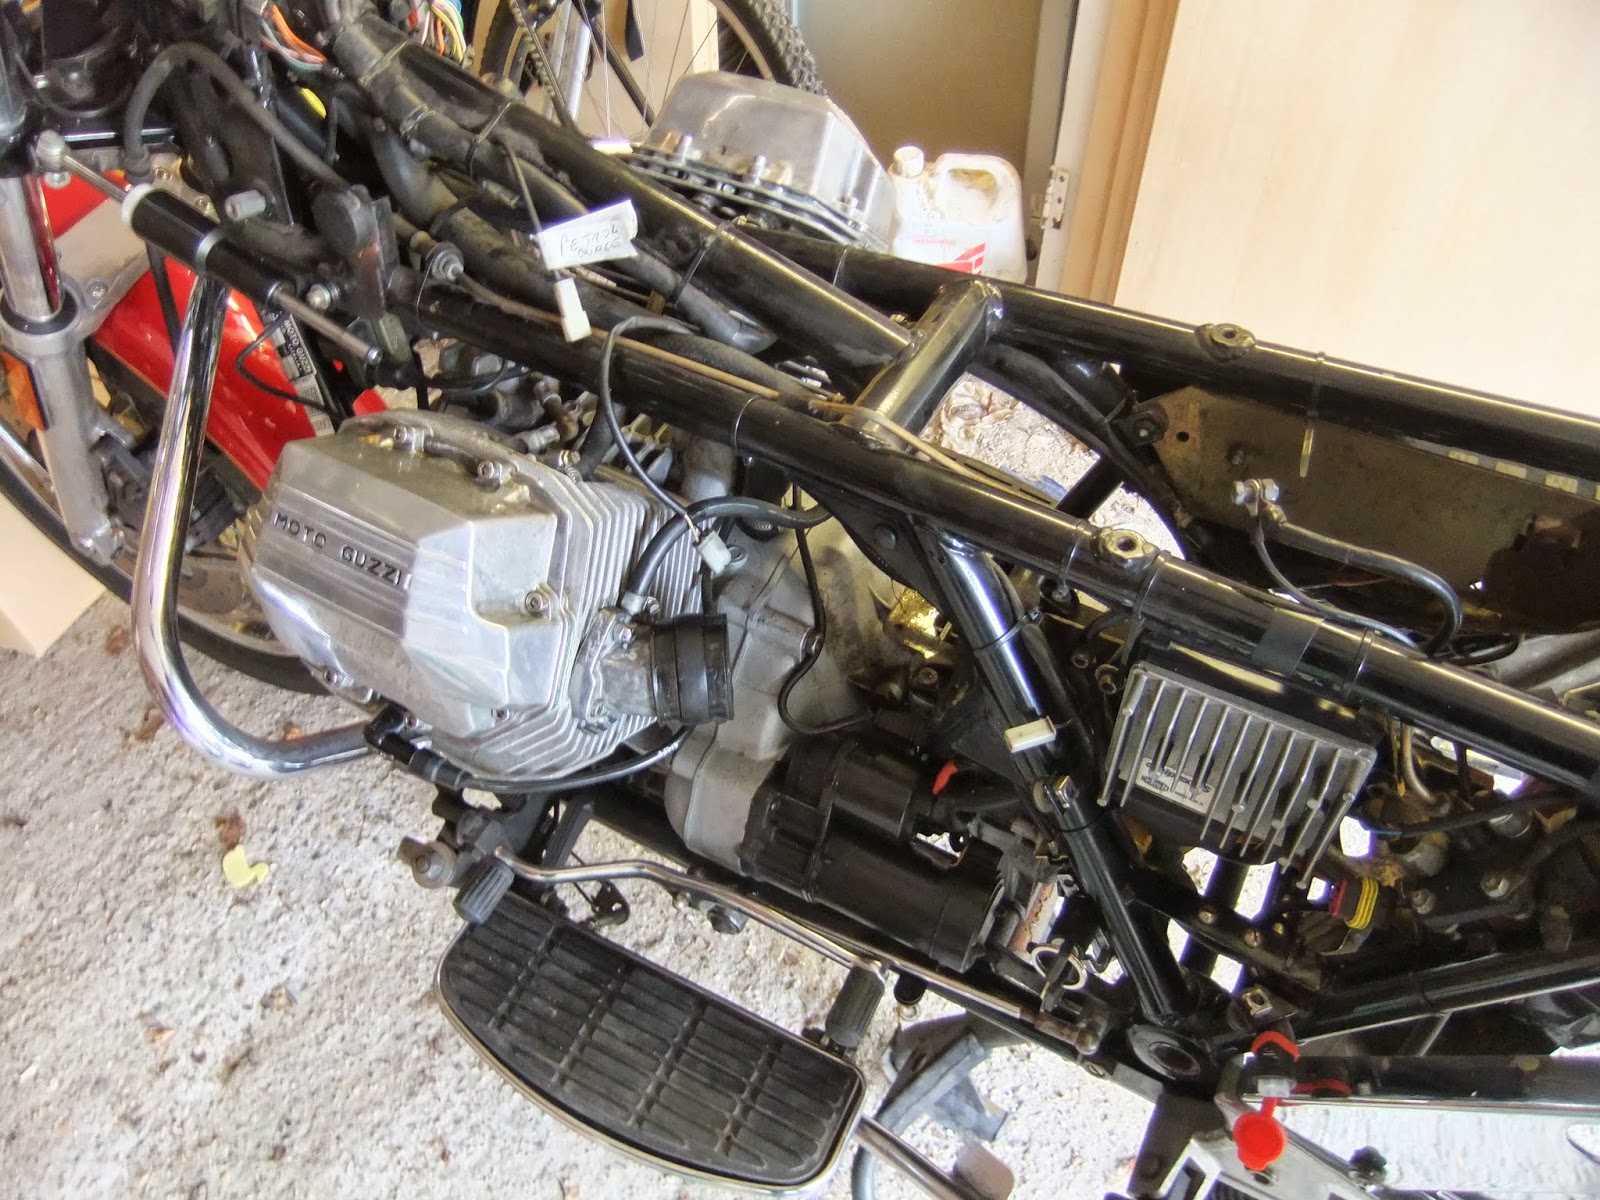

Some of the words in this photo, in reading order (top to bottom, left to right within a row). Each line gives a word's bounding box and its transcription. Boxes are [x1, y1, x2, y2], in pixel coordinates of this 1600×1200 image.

[284, 319, 300, 347] MOTO
[273, 512, 327, 549] MOTO
[340, 544, 402, 586] GUZZI
